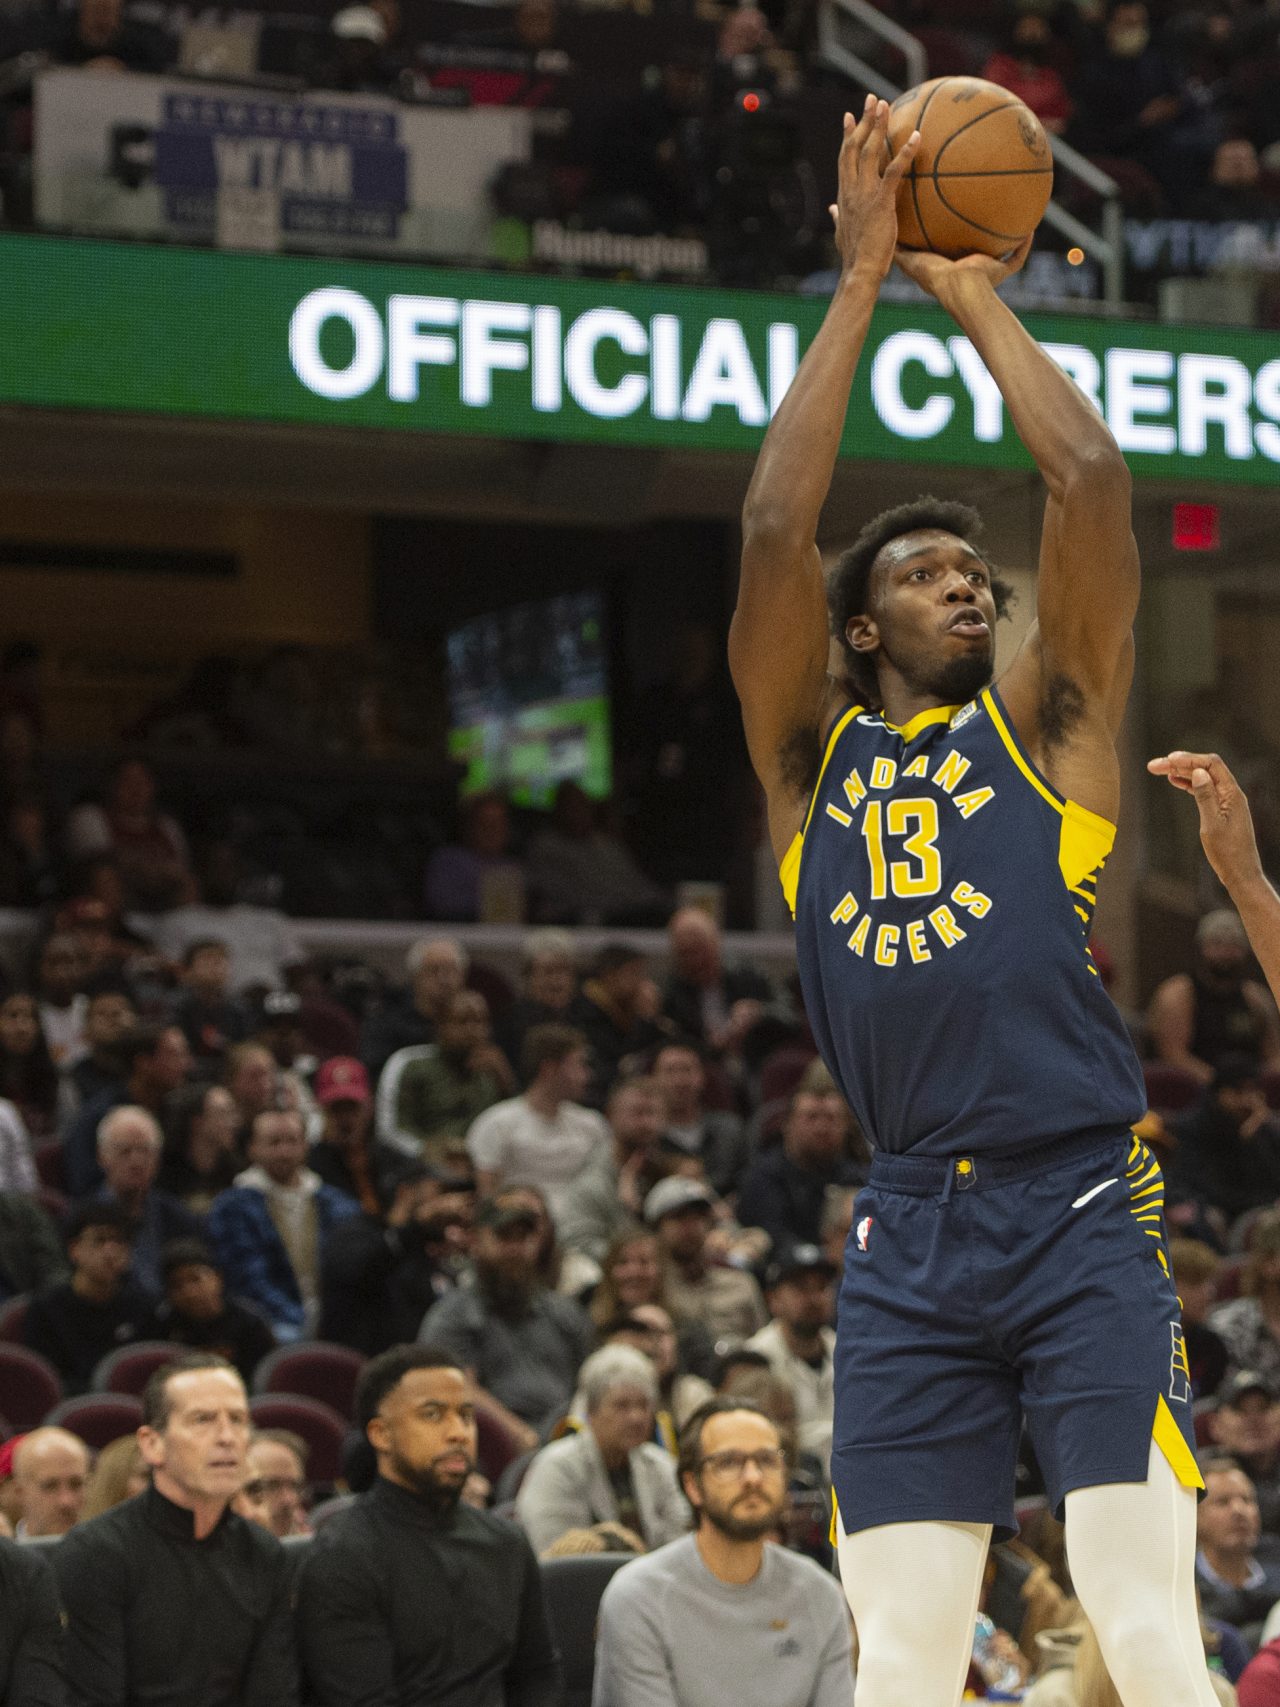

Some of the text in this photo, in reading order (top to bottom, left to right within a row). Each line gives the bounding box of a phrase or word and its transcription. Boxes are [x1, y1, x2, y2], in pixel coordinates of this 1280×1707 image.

[532, 218, 707, 279] Huntington
[287, 286, 801, 426] OFFICIAL
[825, 749, 996, 828] INDANA
[861, 797, 942, 900] 13
[830, 880, 993, 967] PACERS
